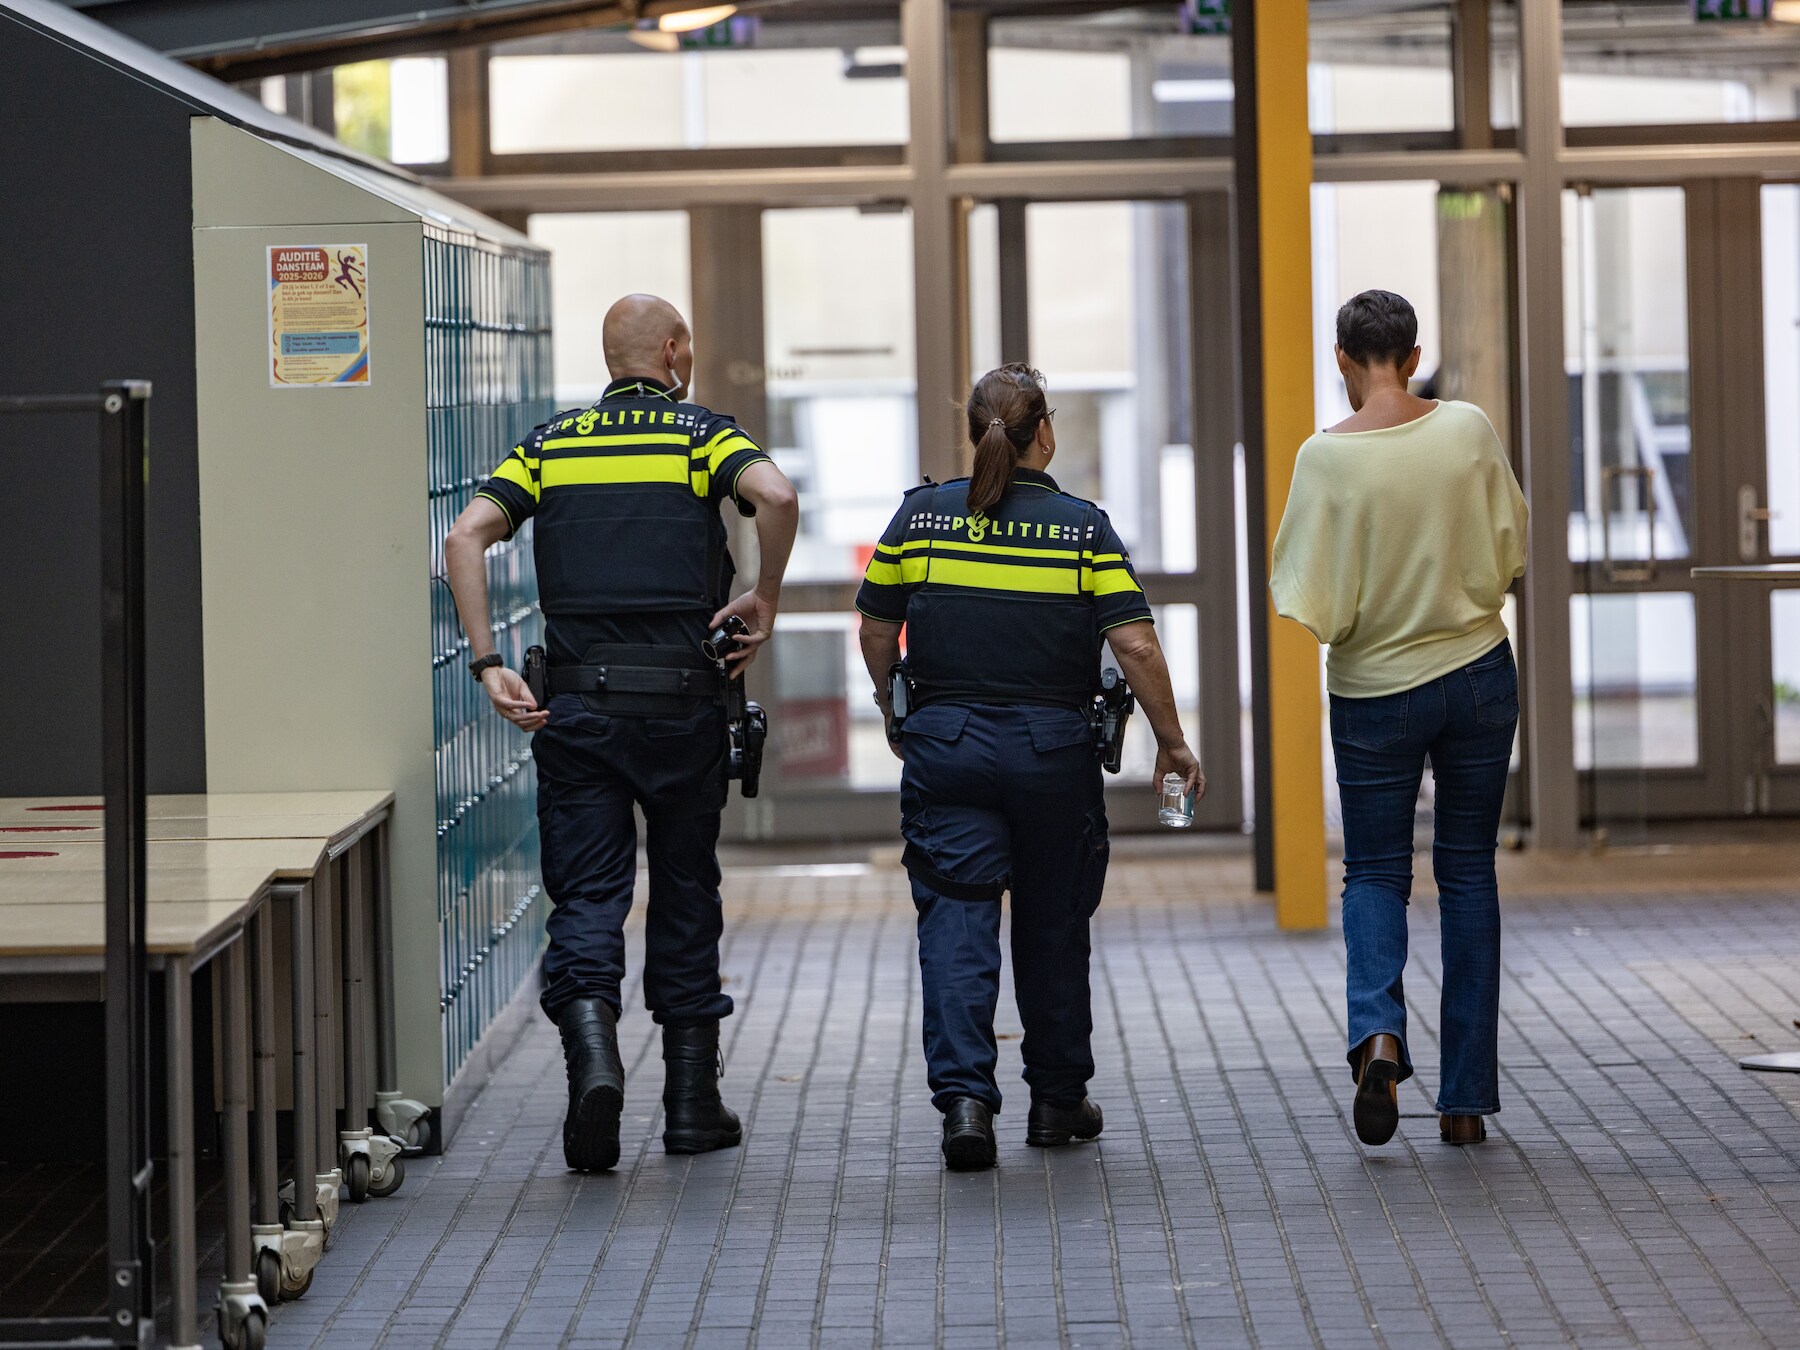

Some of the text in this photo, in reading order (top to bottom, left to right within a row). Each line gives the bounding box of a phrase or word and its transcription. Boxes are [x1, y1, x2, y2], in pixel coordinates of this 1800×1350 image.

[279, 251, 320, 262] AUDITIE
[276, 262, 325, 272] DANSTEAM
[279, 272, 323, 281] 2025-2026
[952, 511, 1061, 542] POLITIE
